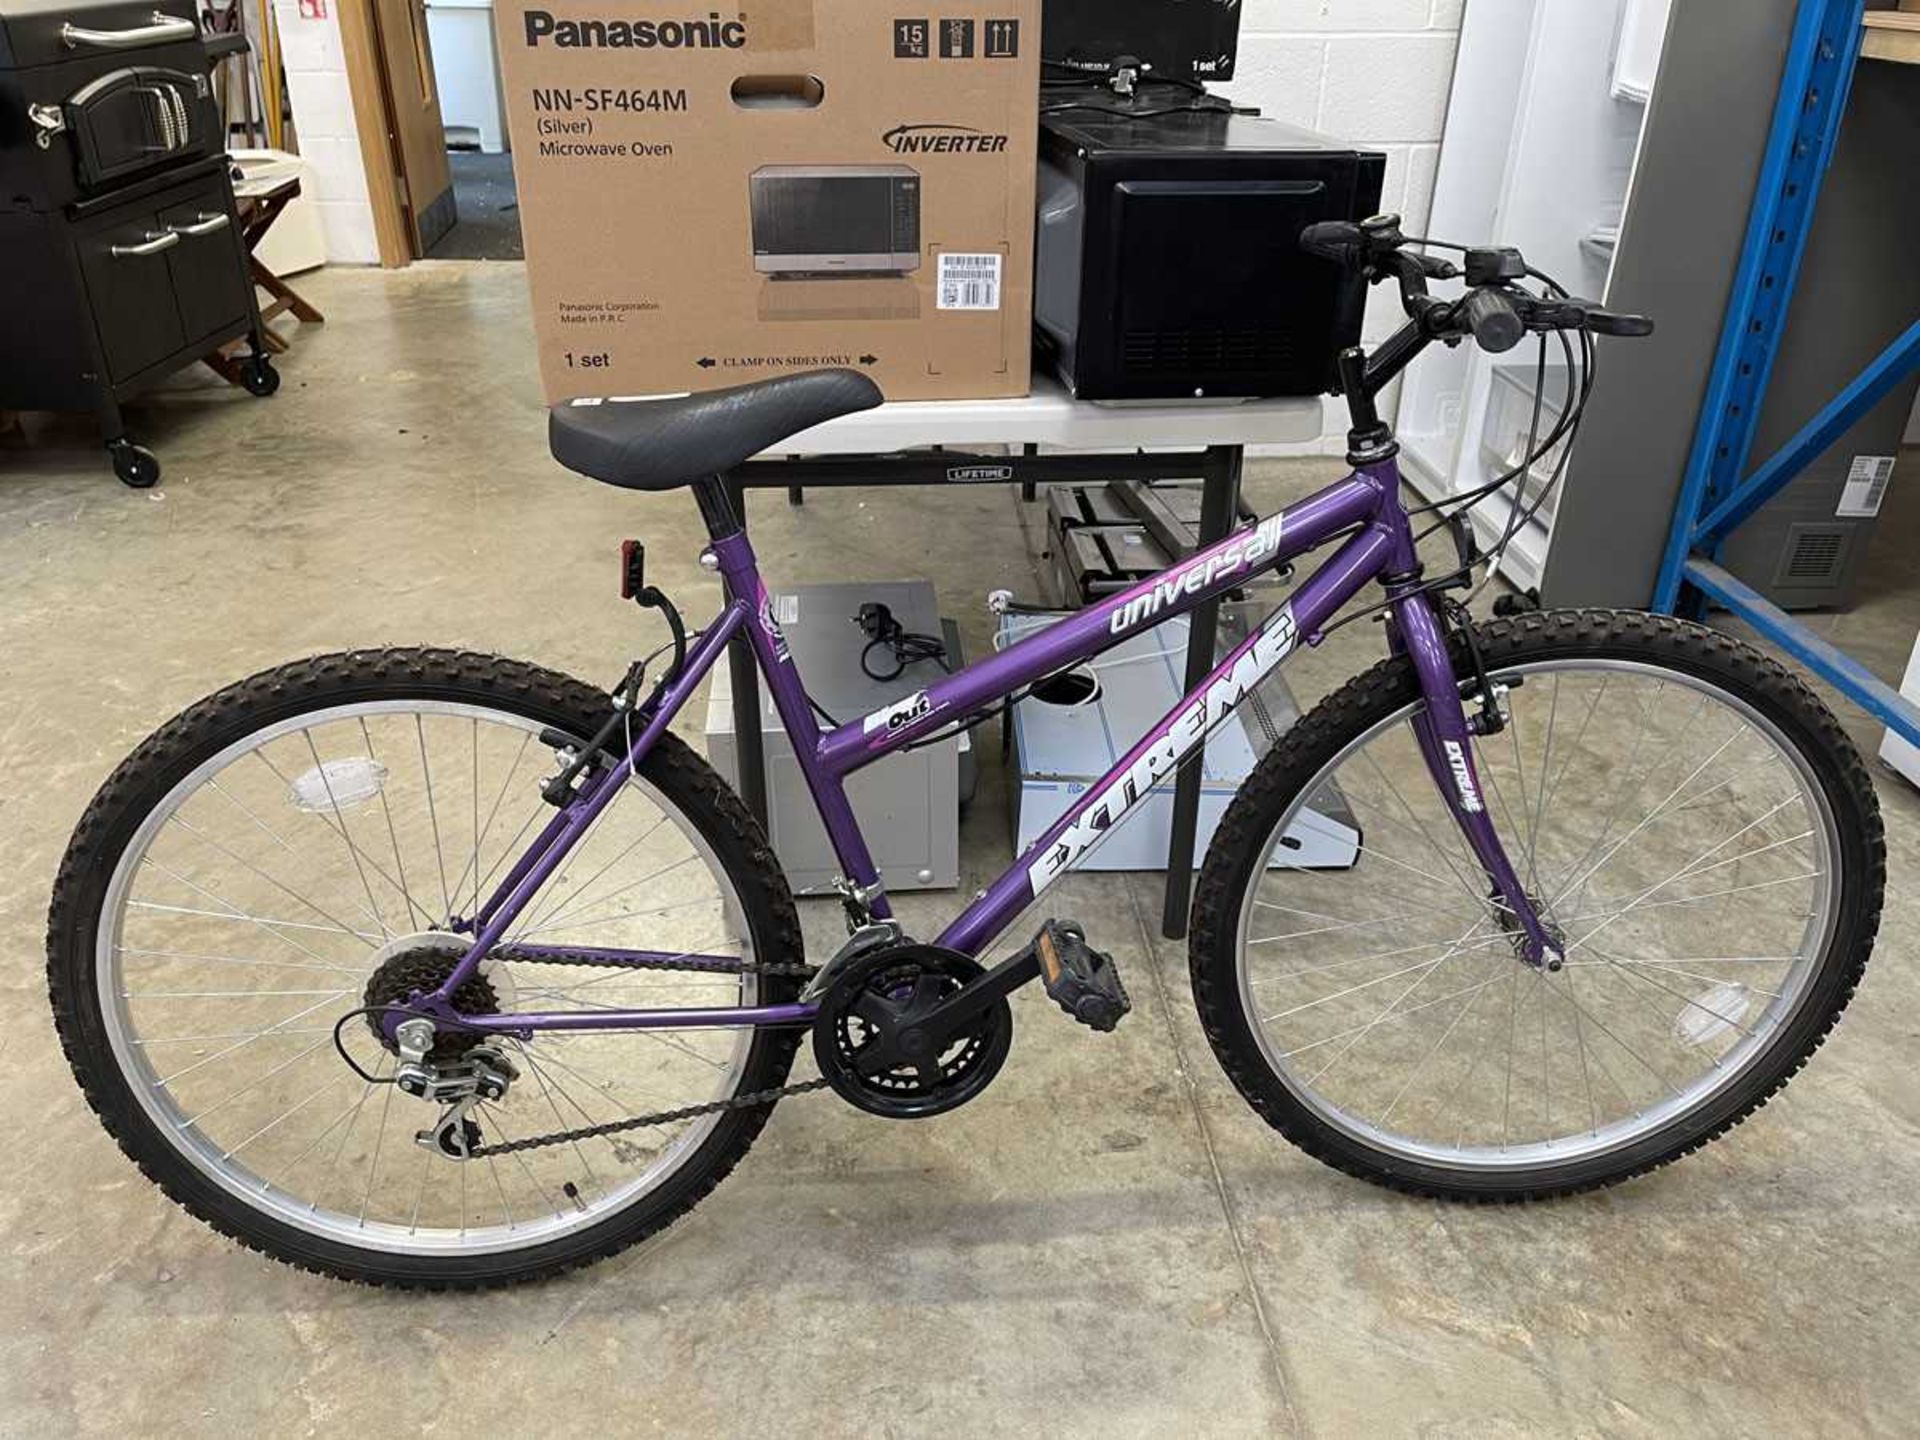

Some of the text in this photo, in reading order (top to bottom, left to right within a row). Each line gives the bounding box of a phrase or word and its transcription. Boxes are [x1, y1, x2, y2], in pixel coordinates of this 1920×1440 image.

[524, 10, 746, 48] Panasonic
[900, 24, 923, 43] 15
[1199, 60, 1216, 71] set
[532, 88, 687, 112] NN-SF464M
[536, 118, 593, 136] (Silver)
[540, 140, 673, 156] Microwave Oven
[895, 135, 1008, 153] INVERTER
[559, 302, 660, 312] Panasonic Corporation
[560, 314, 587, 323] Made
[588, 314, 598, 323] in
[564, 352, 610, 368] 1 set
[723, 355, 852, 368] CLAMP ON SIDES ONLY
[954, 469, 1003, 480] LIFETIME
[1029, 605, 1297, 898] EXTREME
[1442, 740, 1484, 813] EXTREME
